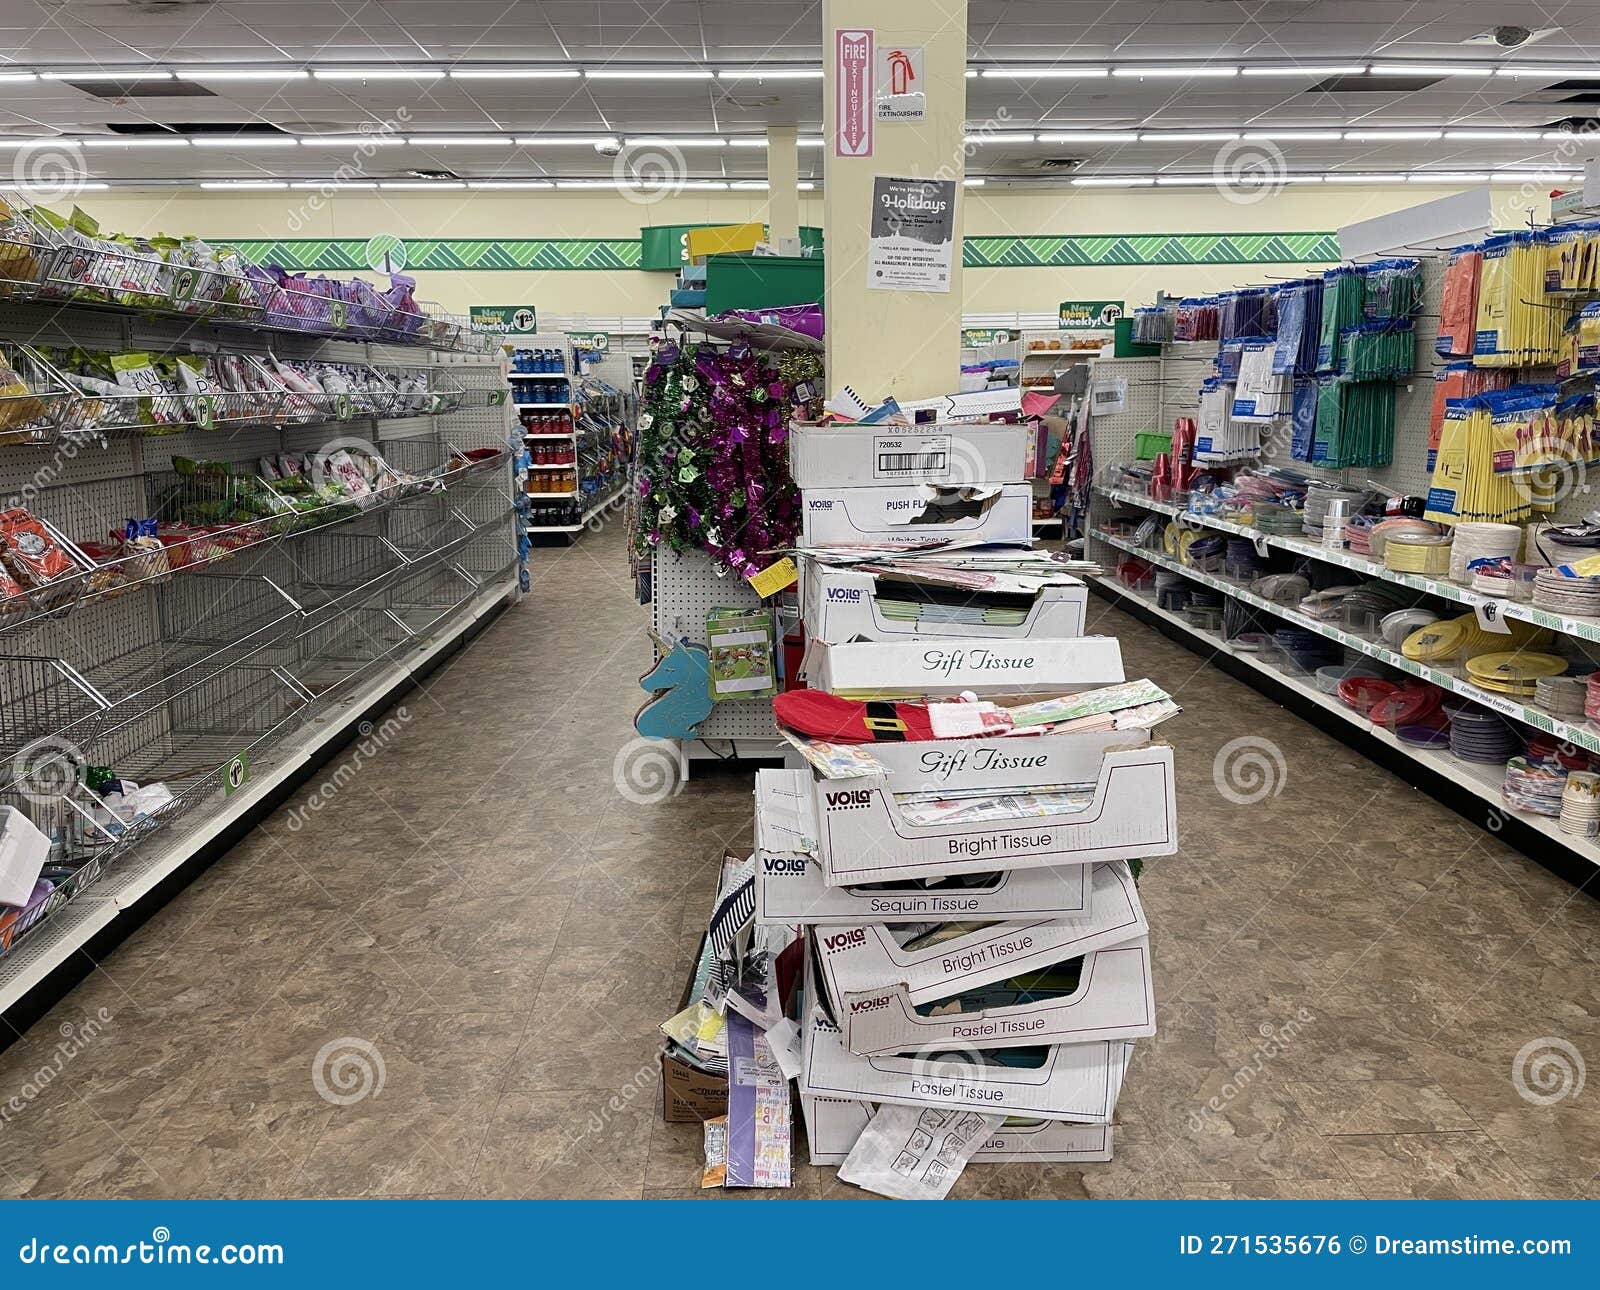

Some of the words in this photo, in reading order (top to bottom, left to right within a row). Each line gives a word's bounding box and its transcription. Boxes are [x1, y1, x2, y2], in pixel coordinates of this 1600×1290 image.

[845, 44, 865, 59] FIRE
[881, 193, 947, 214] Holidays
[482, 308, 506, 317] New
[1062, 310, 1090, 318] Items
[1071, 304, 1094, 312] New
[471, 322, 514, 333] Weekly!
[1059, 318, 1101, 328] Weekly!
[886, 501, 910, 510] PUSH
[922, 650, 965, 678] Gift
[969, 649, 1035, 670] Tissue
[1493, 699, 1517, 714] Everyday
[918, 749, 968, 781] Gift
[973, 748, 1048, 771] Tissue
[949, 836, 998, 856] Bright
[1000, 832, 1052, 849] Tissue
[871, 898, 927, 915] Sequin
[930, 897, 979, 911] Tissue
[943, 951, 986, 974] Bright
[986, 936, 1033, 958] Tissue
[953, 1022, 997, 1037] Pastel
[1000, 1018, 1045, 1033] Tissue
[912, 1081, 956, 1097] Pastel
[959, 1085, 1004, 1101] Tissue
